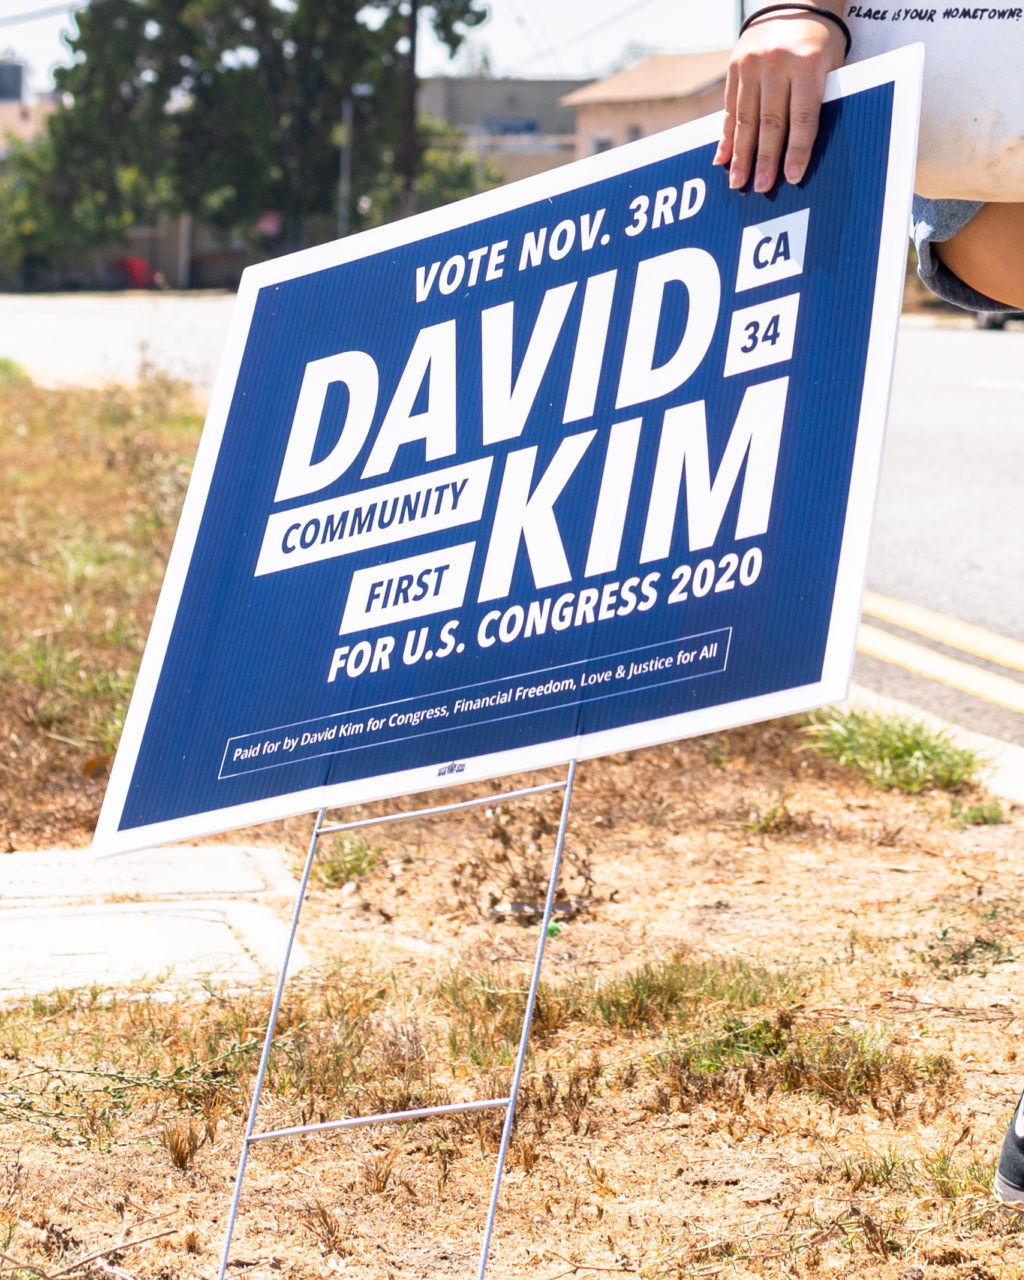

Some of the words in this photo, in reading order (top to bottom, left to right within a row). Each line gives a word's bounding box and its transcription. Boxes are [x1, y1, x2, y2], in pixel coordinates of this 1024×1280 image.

[847, 6, 889, 20] PLACE
[902, 8, 937, 22] YOUR
[942, 7, 1023, 21] HOMETOWN?
[416, 240, 508, 302] VOTE
[519, 209, 610, 271] NOV.
[625, 178, 705, 236] 3RD
[753, 231, 790, 269] CA
[274, 247, 722, 504] DAVID
[741, 315, 780, 353] 34
[281, 478, 468, 554] COMMUNITY
[477, 375, 789, 604] KIM
[328, 636, 395, 682] FOR
[403, 620, 464, 665] U.S.
[477, 568, 660, 647] CONGRESS
[668, 548, 762, 604] 2020
[365, 564, 450, 613] FIRST
[233, 743, 261, 761] Paid
[263, 741, 281, 754] for
[283, 737, 299, 752] by
[301, 726, 337, 745] David
[339, 723, 363, 737] Kim
[367, 718, 386, 731] for
[389, 706, 449, 727] Congress,
[454, 689, 512, 713] Financial
[515, 679, 576, 700] Freedom,
[581, 671, 612, 686] Love
[615, 665, 625, 678] &
[627, 657, 673, 679] Justice
[677, 650, 697, 665] for
[699, 643, 717, 660] All
